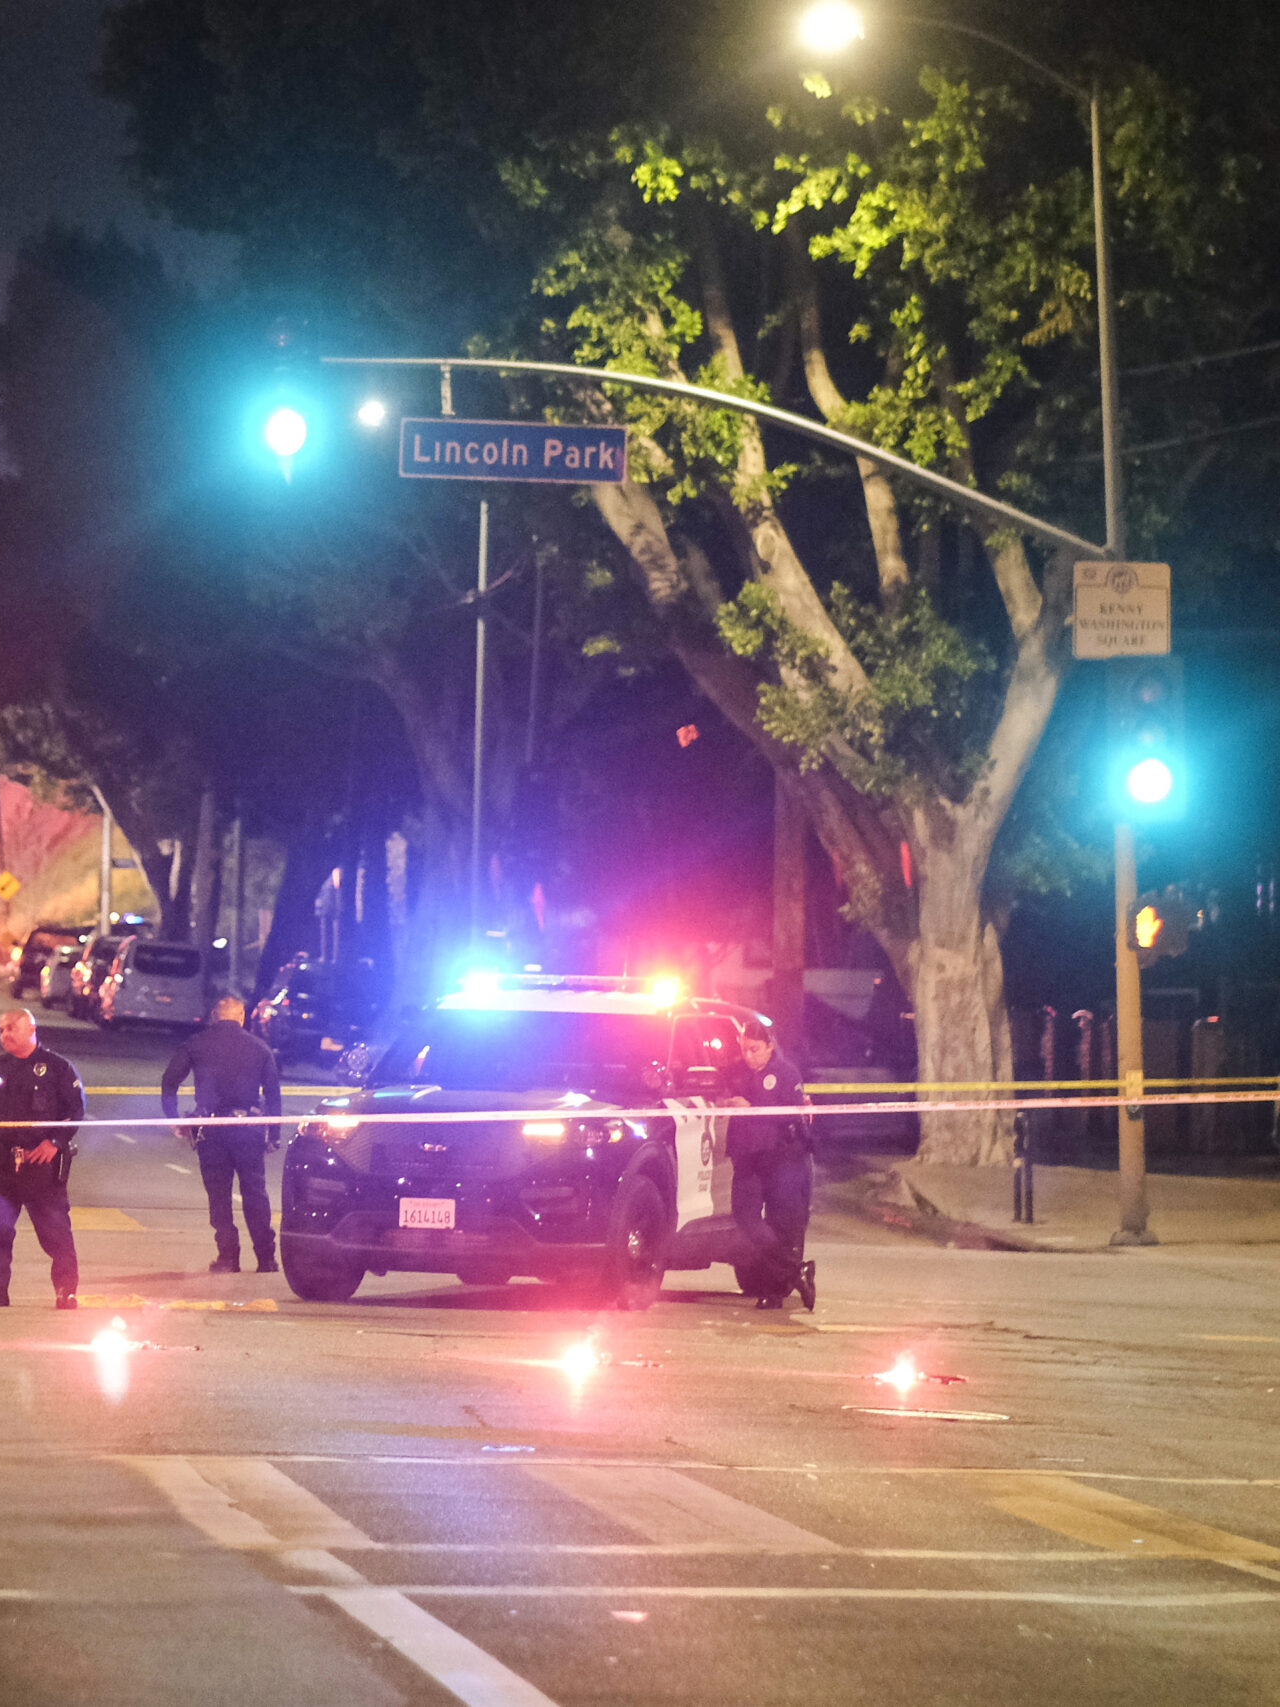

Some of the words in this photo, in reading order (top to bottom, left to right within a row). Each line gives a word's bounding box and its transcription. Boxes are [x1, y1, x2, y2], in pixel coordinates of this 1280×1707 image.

[413, 433, 528, 466] Lincoln
[544, 438, 614, 470] Park
[1099, 602, 1143, 616] KENNY
[1079, 618, 1165, 631] WASHINGTON
[403, 1209, 451, 1224] 1614148
